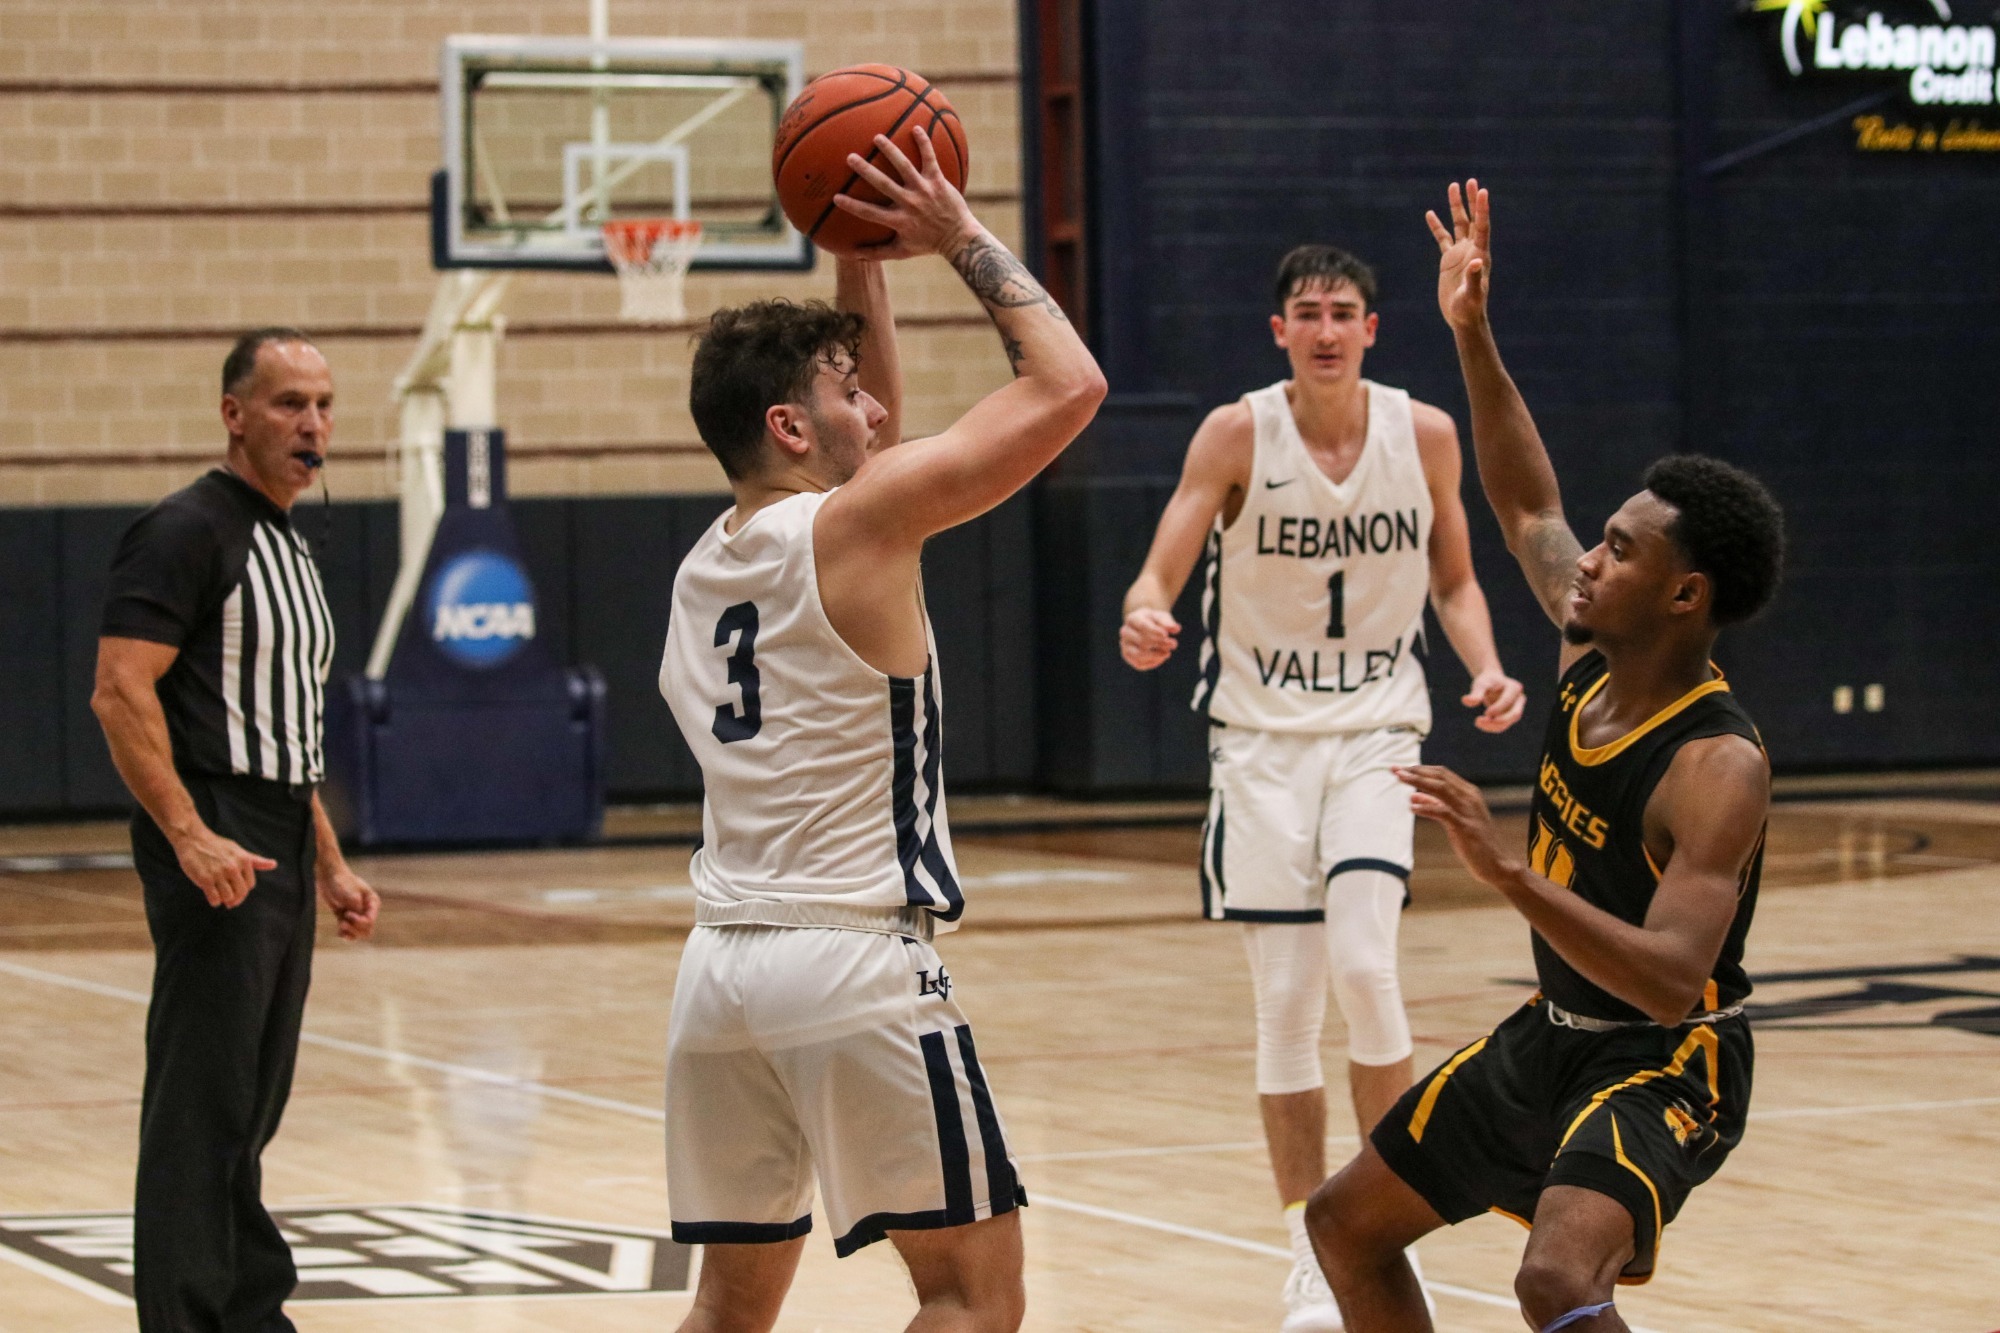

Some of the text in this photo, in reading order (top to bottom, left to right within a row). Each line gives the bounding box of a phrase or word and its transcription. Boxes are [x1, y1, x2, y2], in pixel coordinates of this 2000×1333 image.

[1816, 11, 1995, 68] Lebanon
[1910, 66, 1993, 104] Credit
[1257, 508, 1418, 558] LEBANON
[434, 602, 536, 639] NCAA
[1326, 570, 1346, 639] 1
[712, 600, 762, 744] 3
[1253, 637, 1402, 693] VALLEY
[1541, 752, 1609, 850] GGIES
